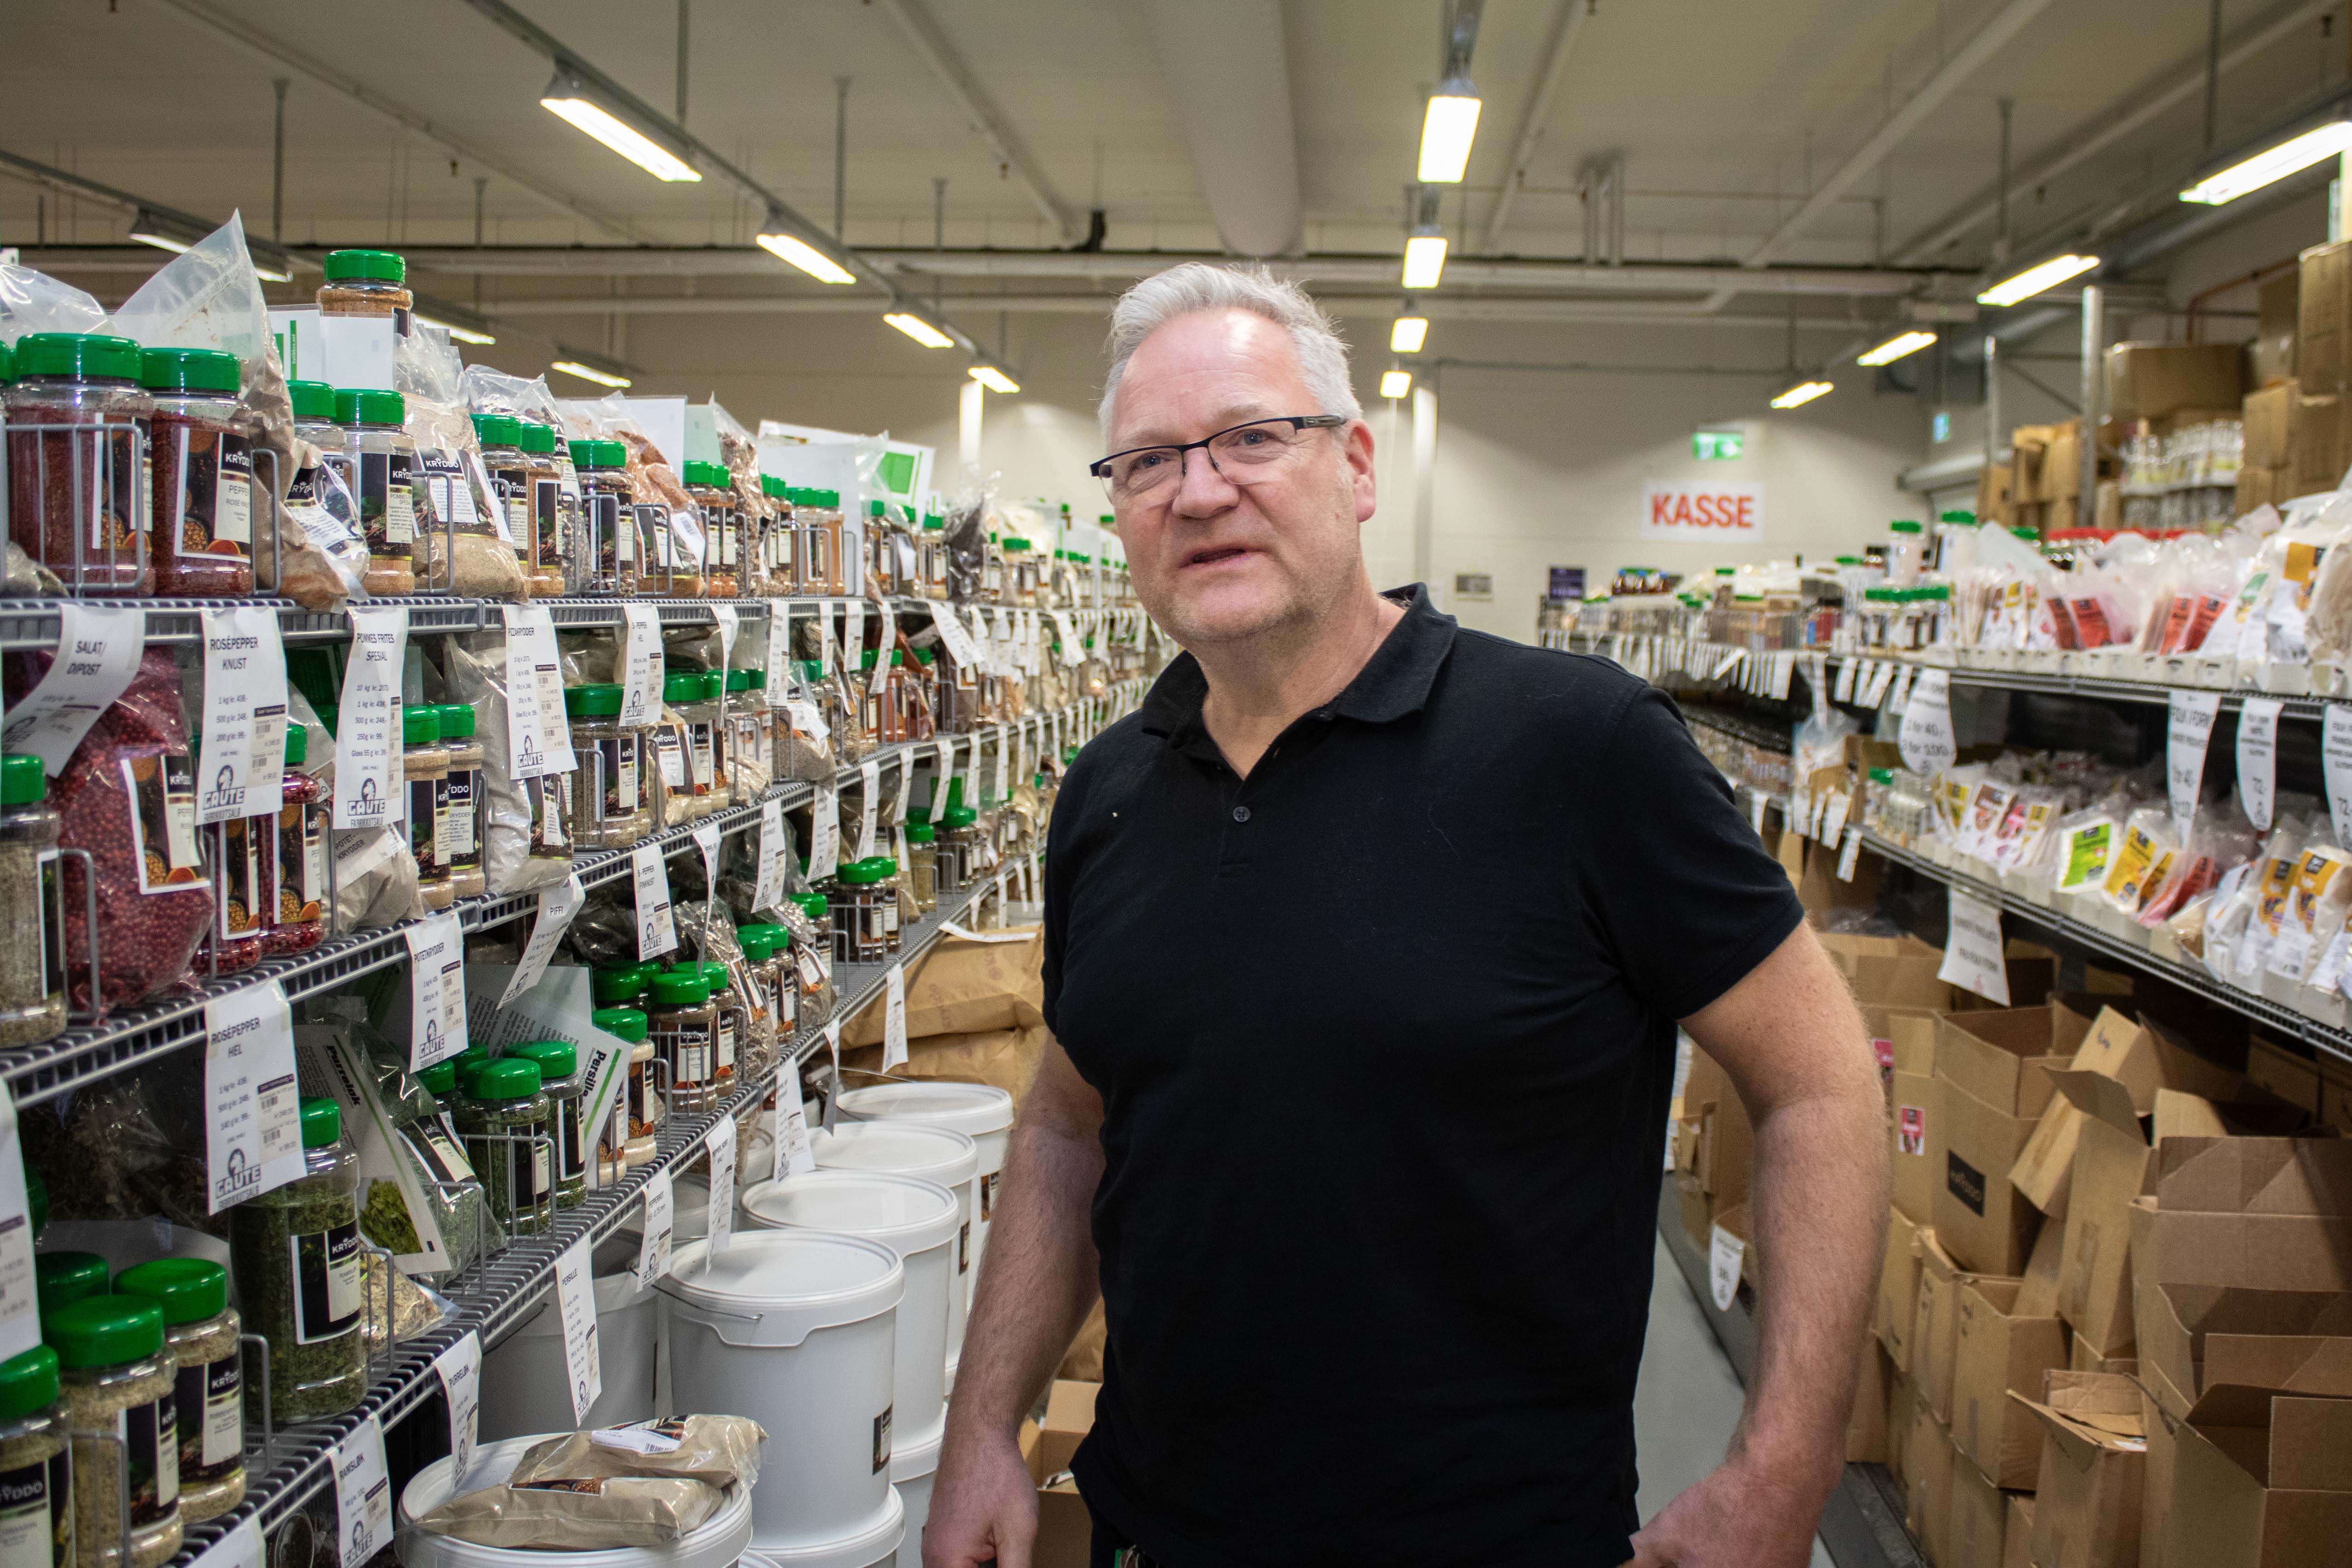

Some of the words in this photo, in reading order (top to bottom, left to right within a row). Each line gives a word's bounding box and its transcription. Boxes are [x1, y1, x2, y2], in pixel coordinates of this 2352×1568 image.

[225, 454, 250, 467] KRYDD
[425, 460, 459, 468] KRYDDO
[393, 471, 413, 480] KRYDD
[291, 482, 313, 493] RYDDO
[1652, 493, 1753, 529] KASSE
[508, 627, 535, 636] PIZZAKRYDDER
[210, 635, 259, 651] ROSÉPEPPER
[356, 633, 377, 644] POMMES
[378, 634, 395, 643] FRITES
[366, 651, 388, 661] SPESIAL
[222, 658, 247, 670] KNUST
[364, 684, 370, 693] kg
[362, 700, 368, 709] kg
[348, 799, 385, 816] GAUTE
[335, 834, 356, 850] POTET-
[337, 839, 365, 861] KRYDDER
[550, 906, 564, 916] PIFFI
[414, 942, 444, 963] POTETKRYDDER
[211, 1017, 261, 1045] ROSÉPEPPER
[583, 1049, 607, 1097] Persille
[332, 1236, 358, 1254] KRYDD
[562, 1268, 577, 1286] PERSILLE
